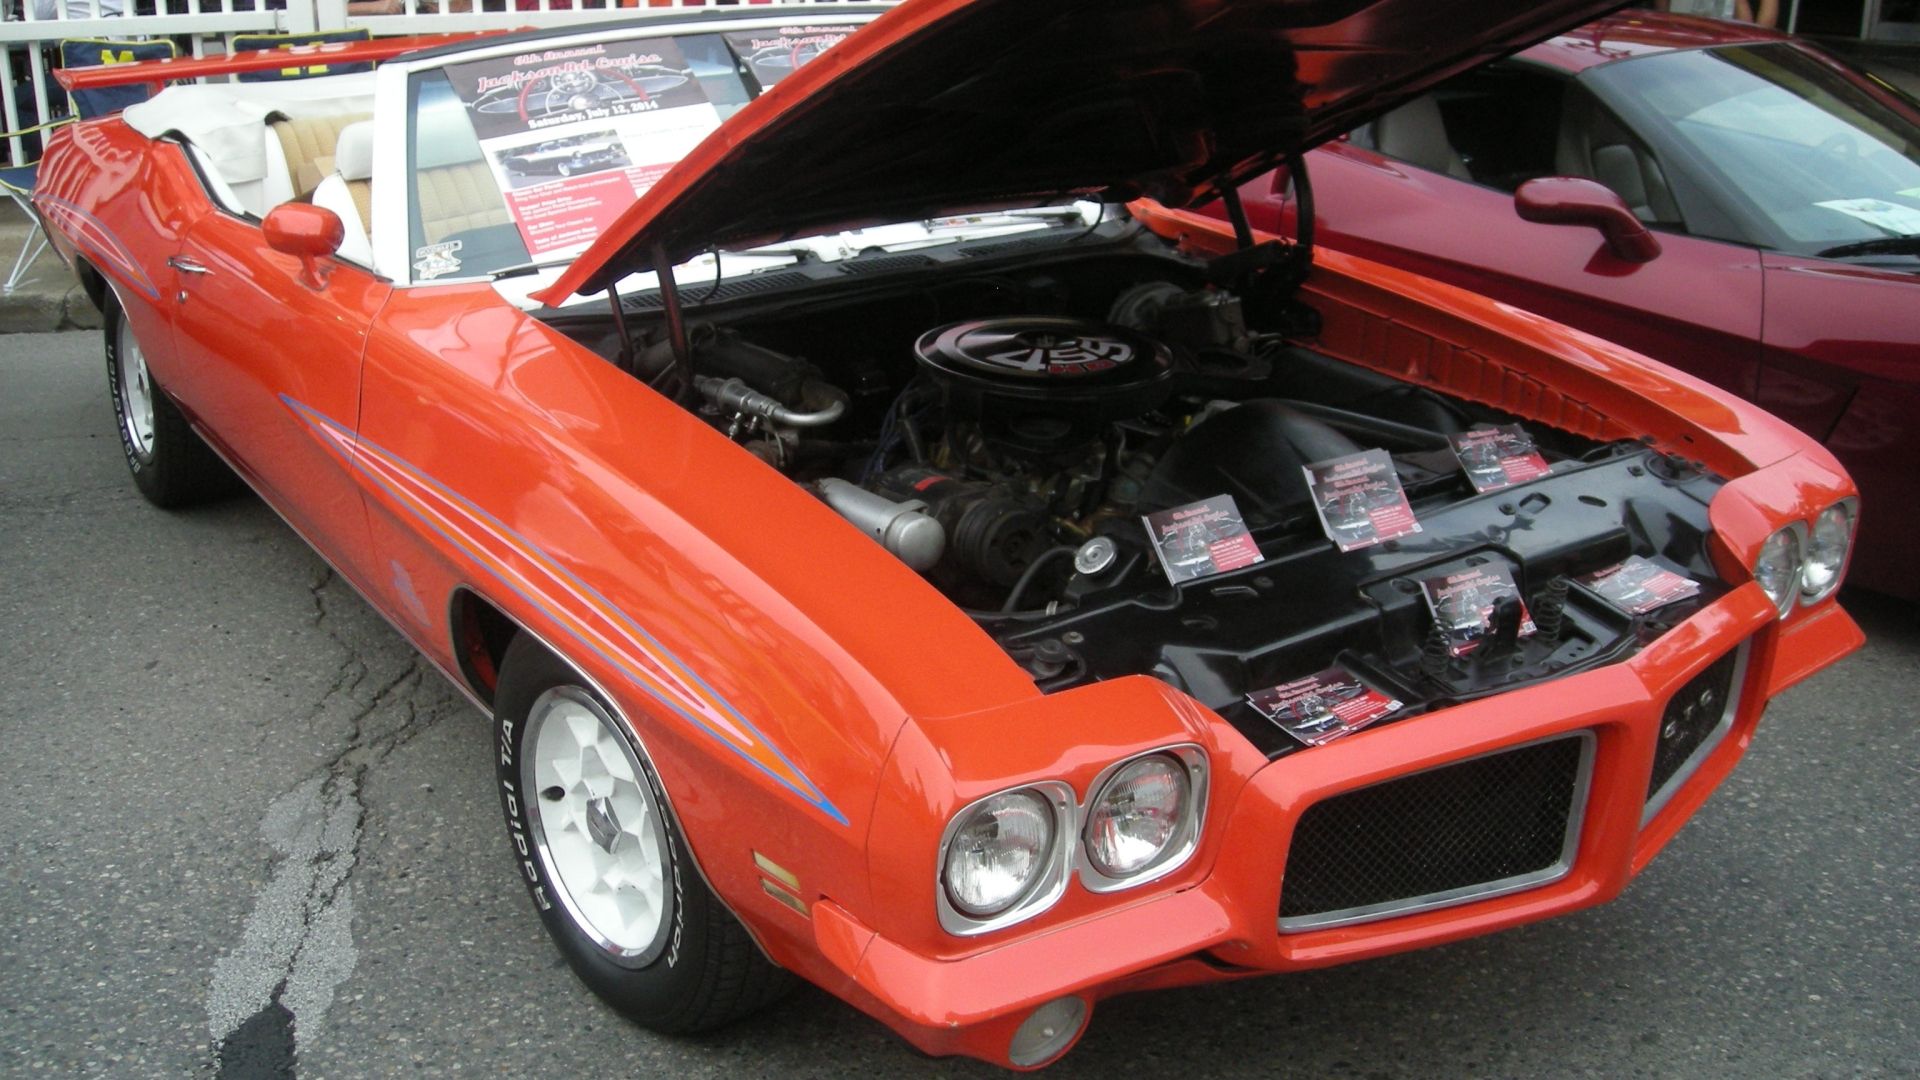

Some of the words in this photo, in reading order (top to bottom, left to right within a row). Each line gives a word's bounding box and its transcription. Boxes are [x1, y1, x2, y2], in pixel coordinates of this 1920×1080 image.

[543, 44, 606, 61] Annual
[477, 66, 564, 93] Jackson
[595, 53, 663, 69] Cruise
[528, 112, 586, 129] Saturday,
[585, 107, 610, 120] July
[612, 103, 631, 116] 12,
[630, 99, 659, 112] 2014
[986, 339, 1132, 372] 455
[501, 719, 514, 767] T/A
[504, 780, 551, 911] Radial
